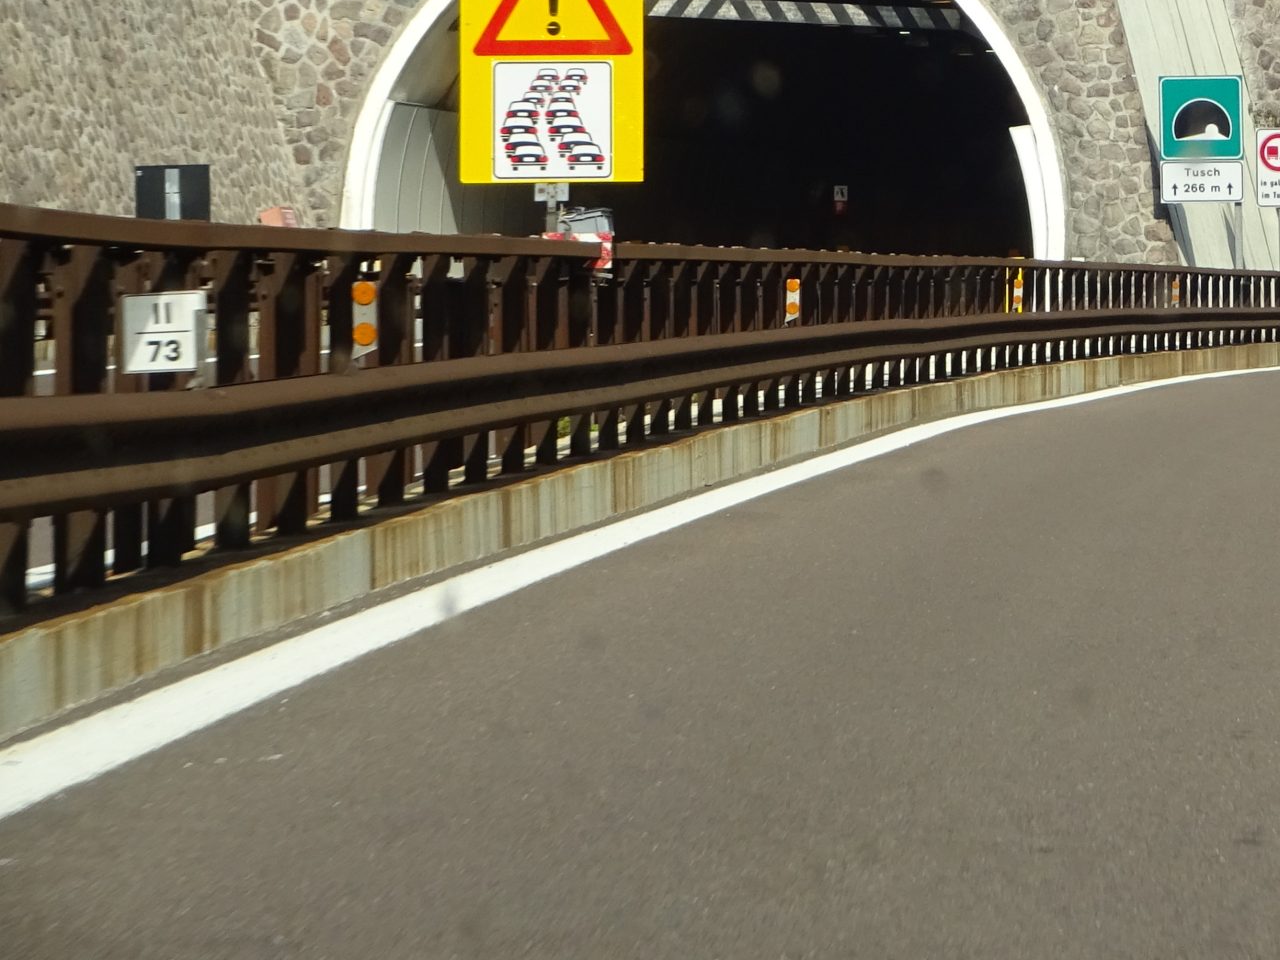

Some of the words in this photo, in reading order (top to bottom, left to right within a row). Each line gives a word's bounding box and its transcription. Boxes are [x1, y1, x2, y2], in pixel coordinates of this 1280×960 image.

[1183, 167, 1221, 177] Tusch
[1183, 183, 1206, 193] 266
[1210, 185, 1221, 193] m
[1261, 191, 1270, 199] im
[146, 340, 181, 362] 73
